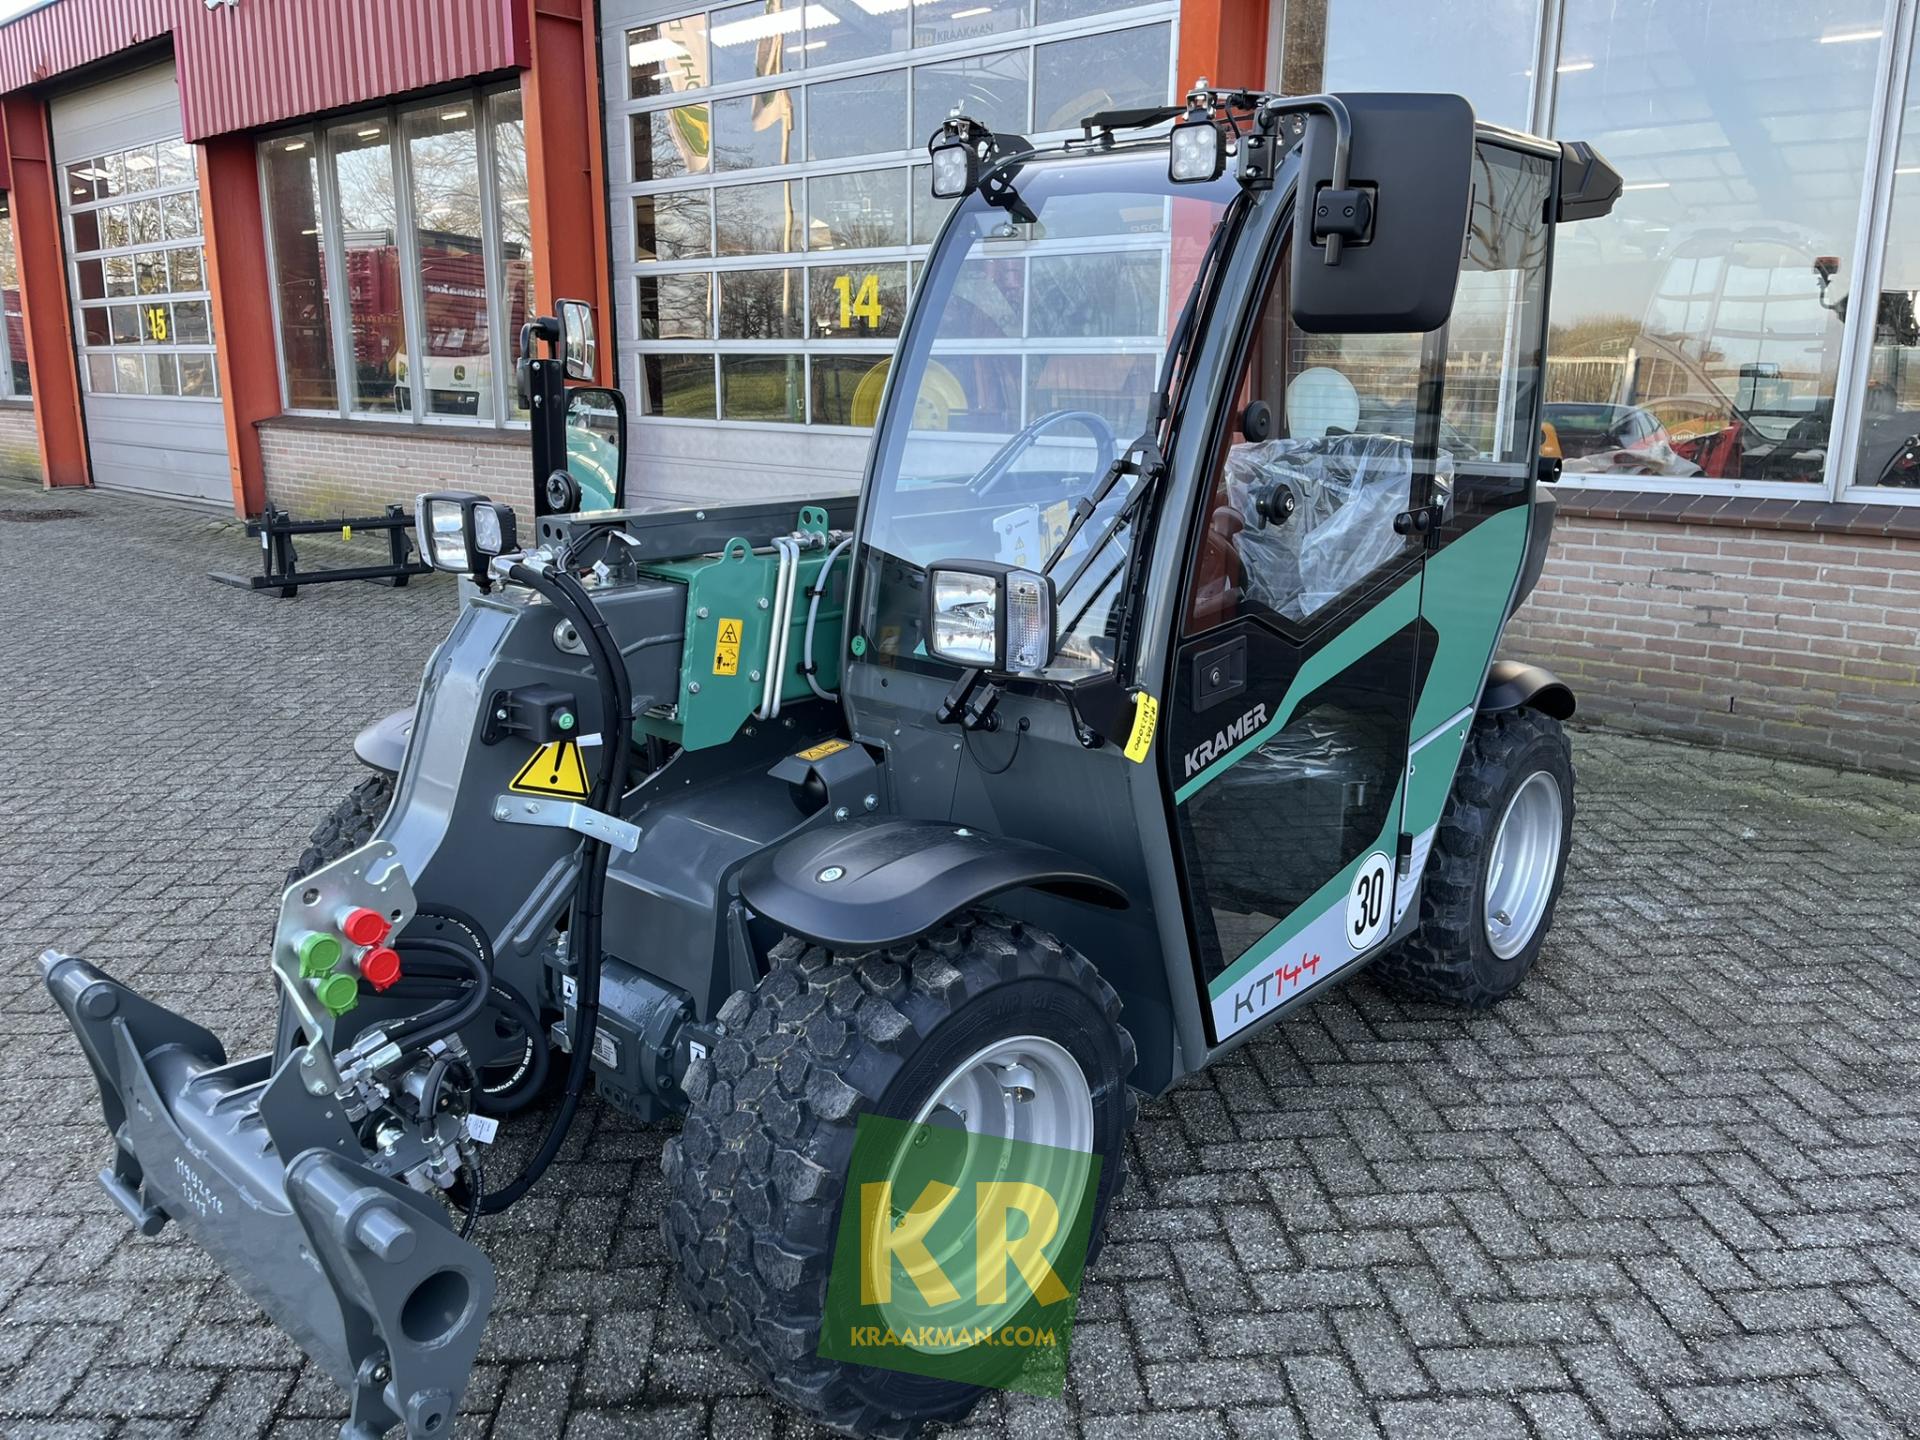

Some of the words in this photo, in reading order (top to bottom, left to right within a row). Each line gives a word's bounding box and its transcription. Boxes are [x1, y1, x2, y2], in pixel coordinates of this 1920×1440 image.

[149, 308, 168, 340] 15
[833, 274, 882, 329] 14
[1184, 702, 1268, 778] KRAMER
[1354, 866, 1385, 936] 30
[1233, 952, 1321, 1024] KT144
